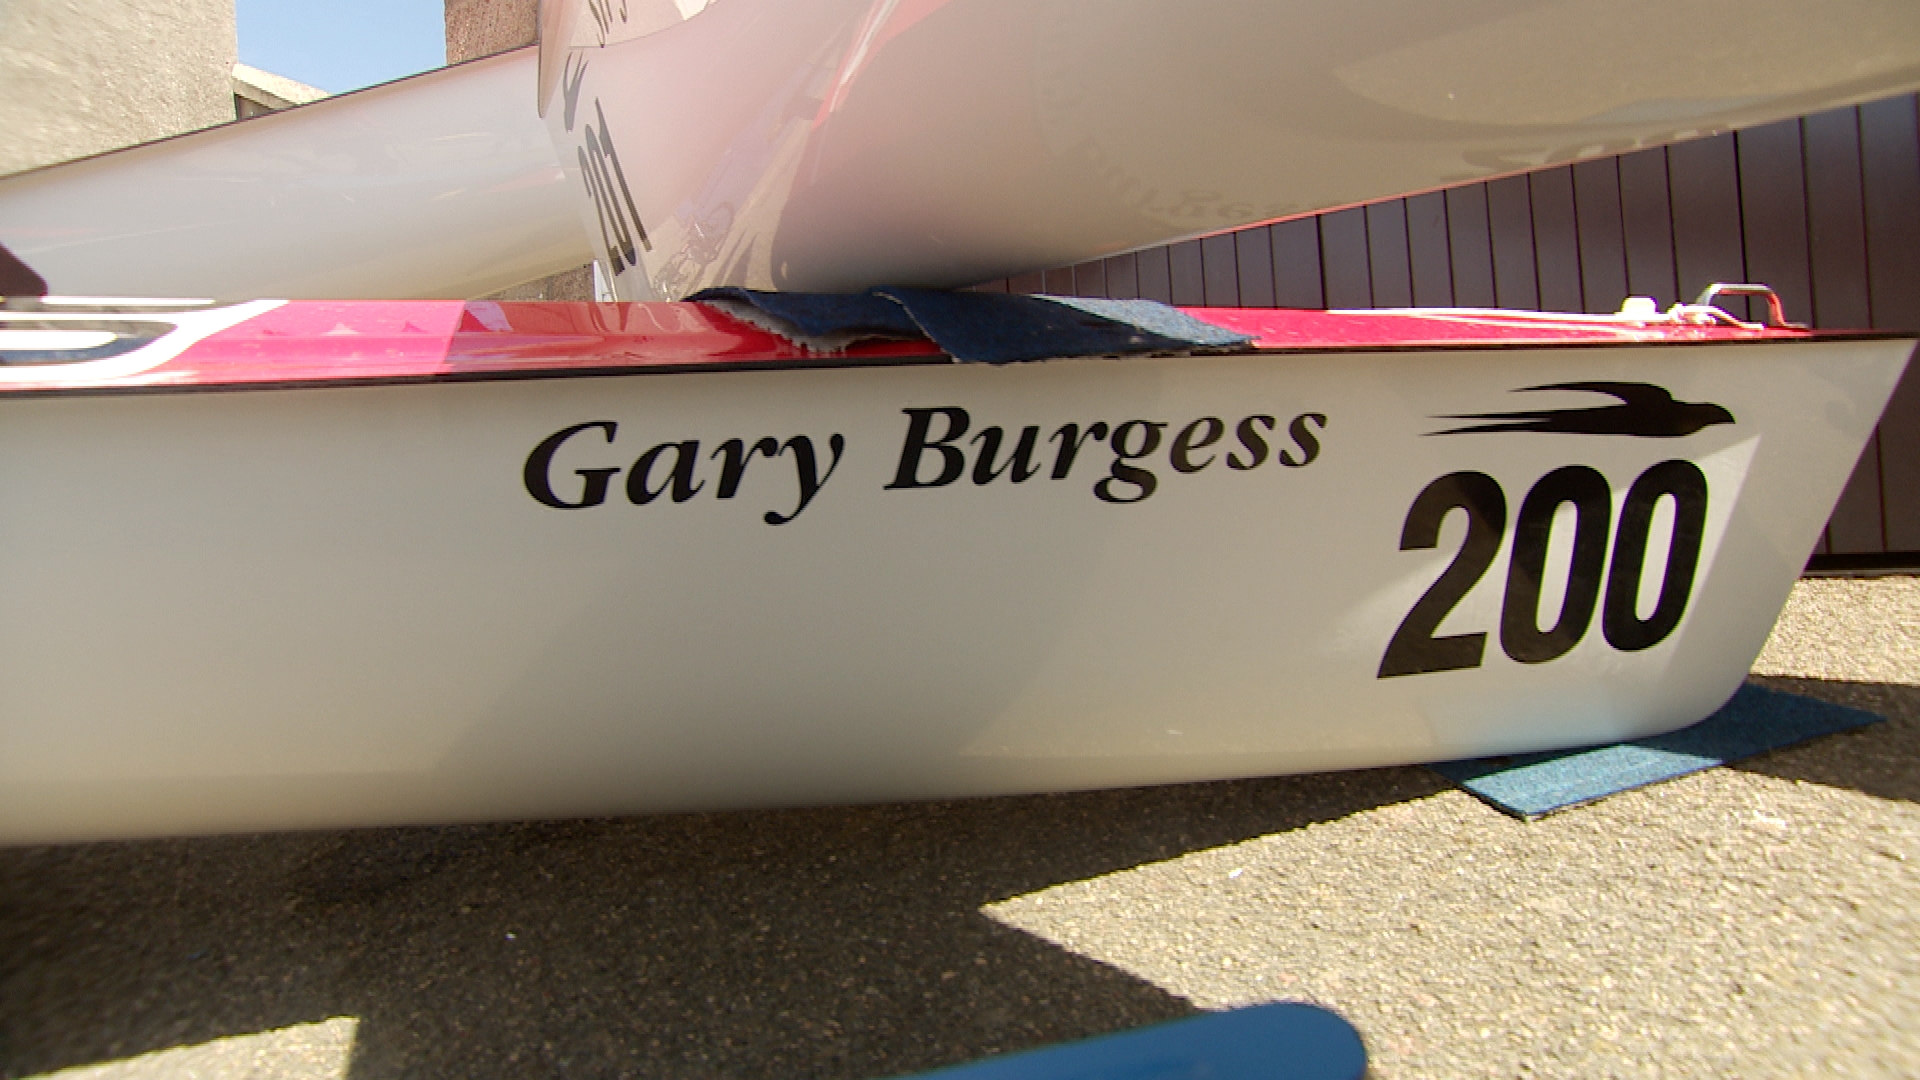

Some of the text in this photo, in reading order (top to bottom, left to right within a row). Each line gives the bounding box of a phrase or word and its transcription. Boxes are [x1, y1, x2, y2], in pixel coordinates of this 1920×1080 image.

[577, 97, 652, 276] 201
[524, 406, 1327, 526] Gary Burgess
[1377, 459, 1708, 678] 200
